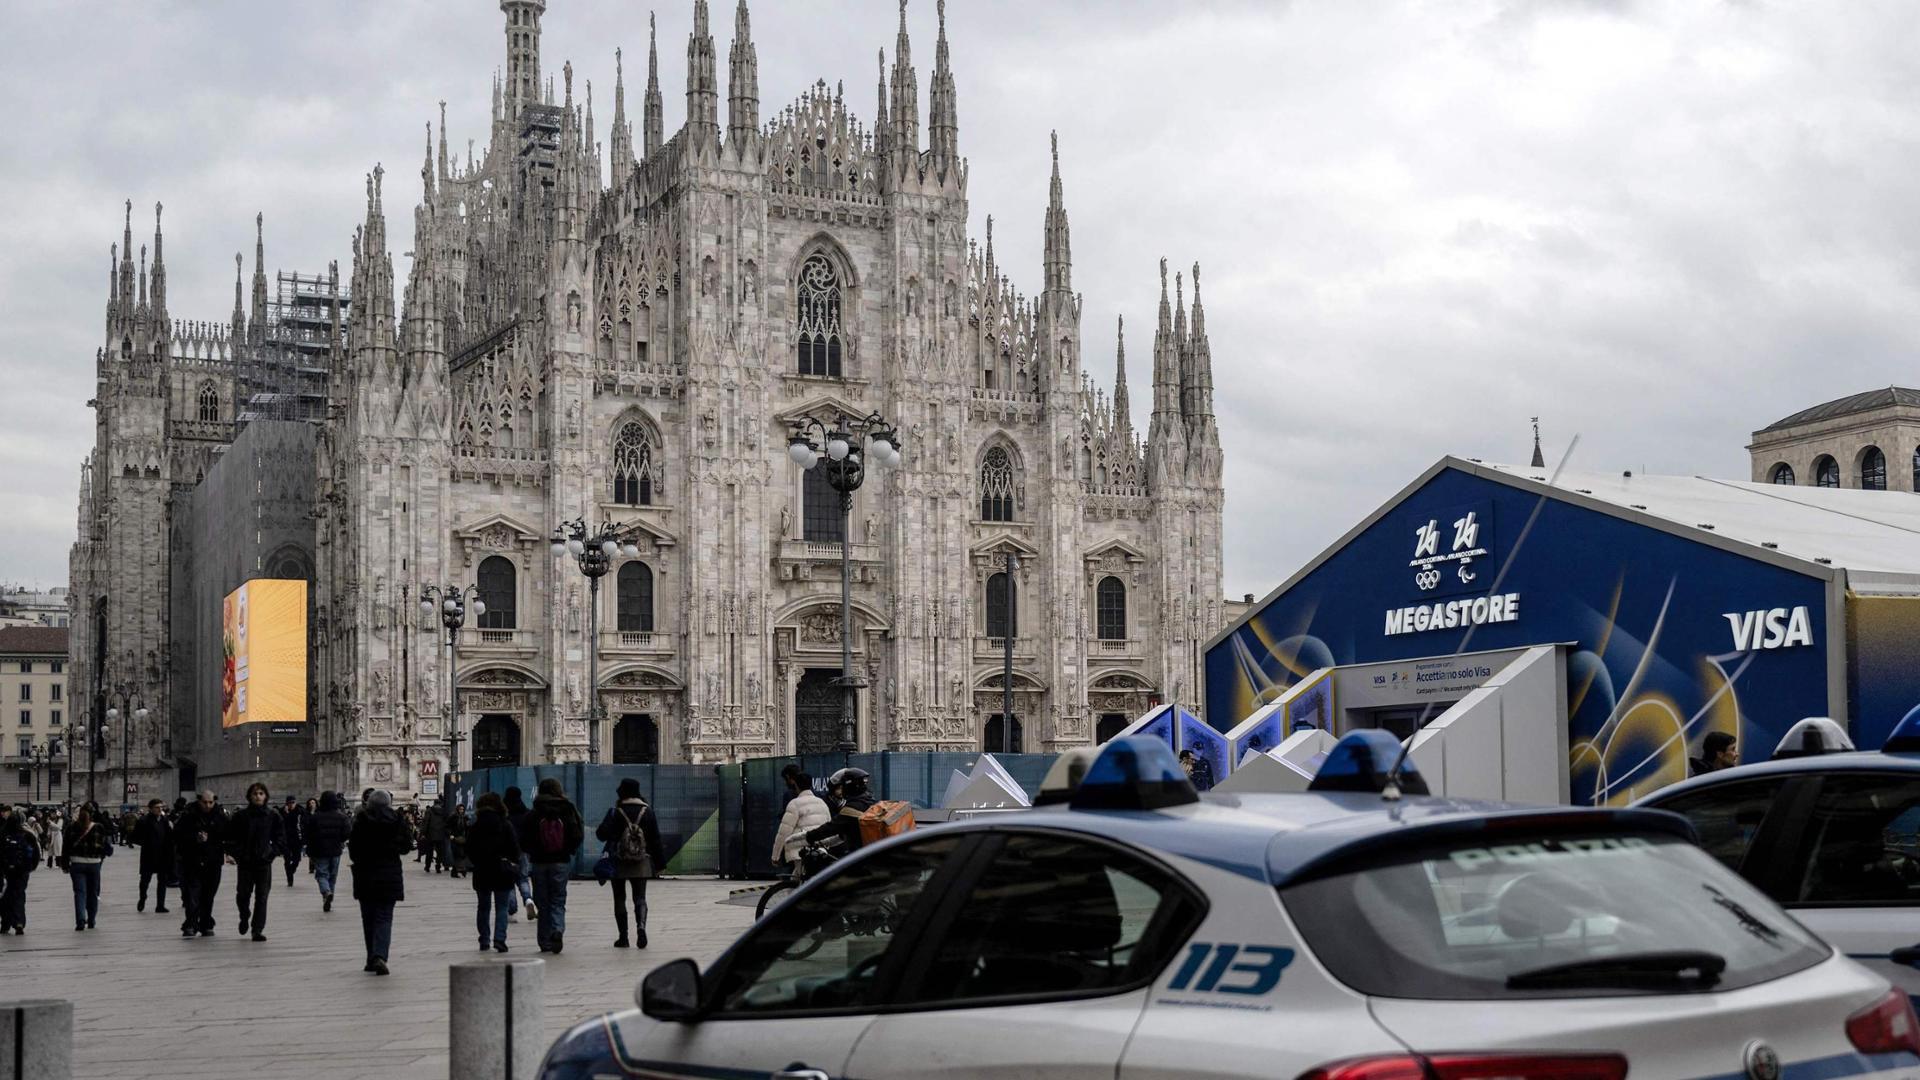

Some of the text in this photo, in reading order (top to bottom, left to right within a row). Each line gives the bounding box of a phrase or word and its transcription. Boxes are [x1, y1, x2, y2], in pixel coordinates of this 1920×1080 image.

[1385, 593, 1519, 636] MEGASTORE
[1722, 606, 1814, 651] VISA
[1457, 667, 1474, 679] solo
[1474, 666, 1491, 677] Visa
[424, 763, 437, 772] M
[127, 784, 137, 792] M
[1167, 943, 1296, 996] 113
